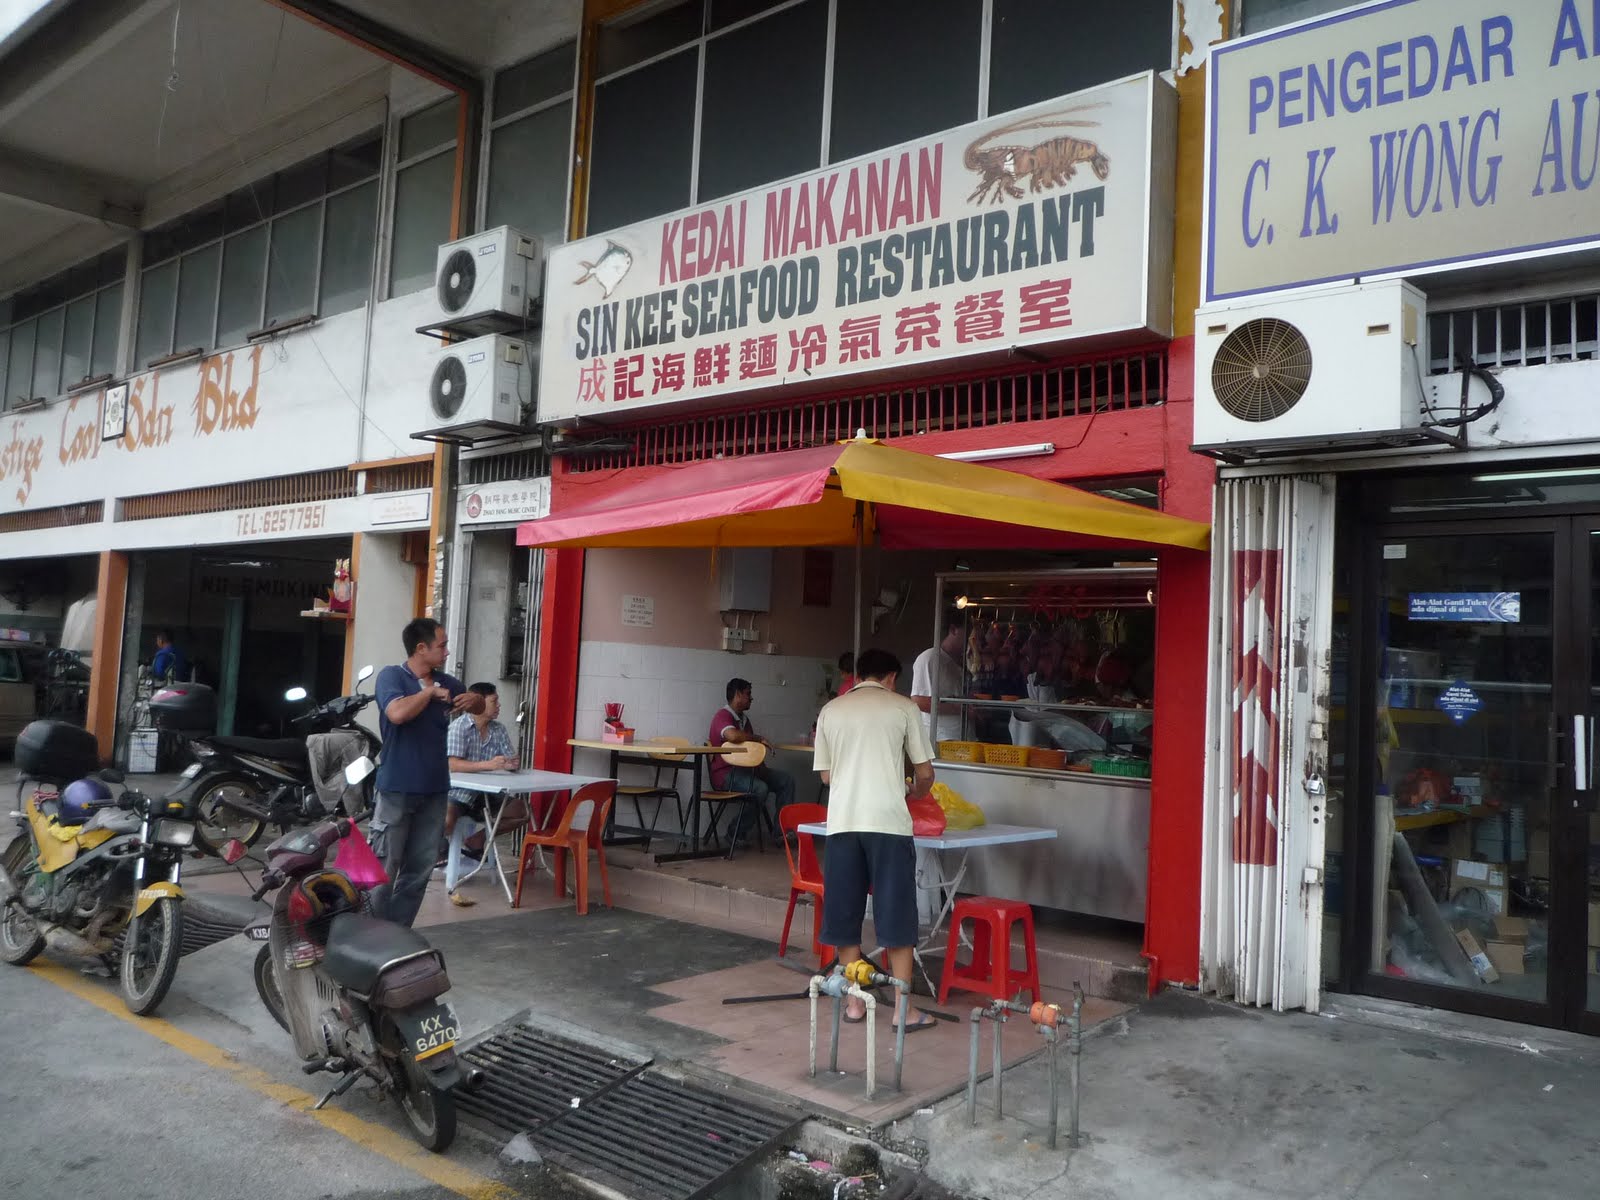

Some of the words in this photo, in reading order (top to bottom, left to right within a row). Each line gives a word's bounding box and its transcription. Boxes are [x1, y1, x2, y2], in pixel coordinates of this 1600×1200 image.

[1249, 15, 1514, 135] PENGEDAR
[659, 200, 747, 286] KEDAI
[763, 143, 944, 261] MAKANAN
[1242, 158, 1274, 248] C.
[1300, 147, 1338, 238] K.
[1370, 108, 1503, 225] WONG
[1531, 89, 1600, 196] AU
[576, 302, 619, 361] SIN
[624, 289, 677, 350] KEE
[681, 256, 820, 339] SEAFOOD
[835, 185, 1105, 308] RESTAURANT
[191, 345, 264, 437] Bhd
[577, 278, 1073, 402] 成記海鮮麵冷氣茶餐室
[416, 1026, 456, 1051] 6470
[421, 1014, 443, 1034] KX
